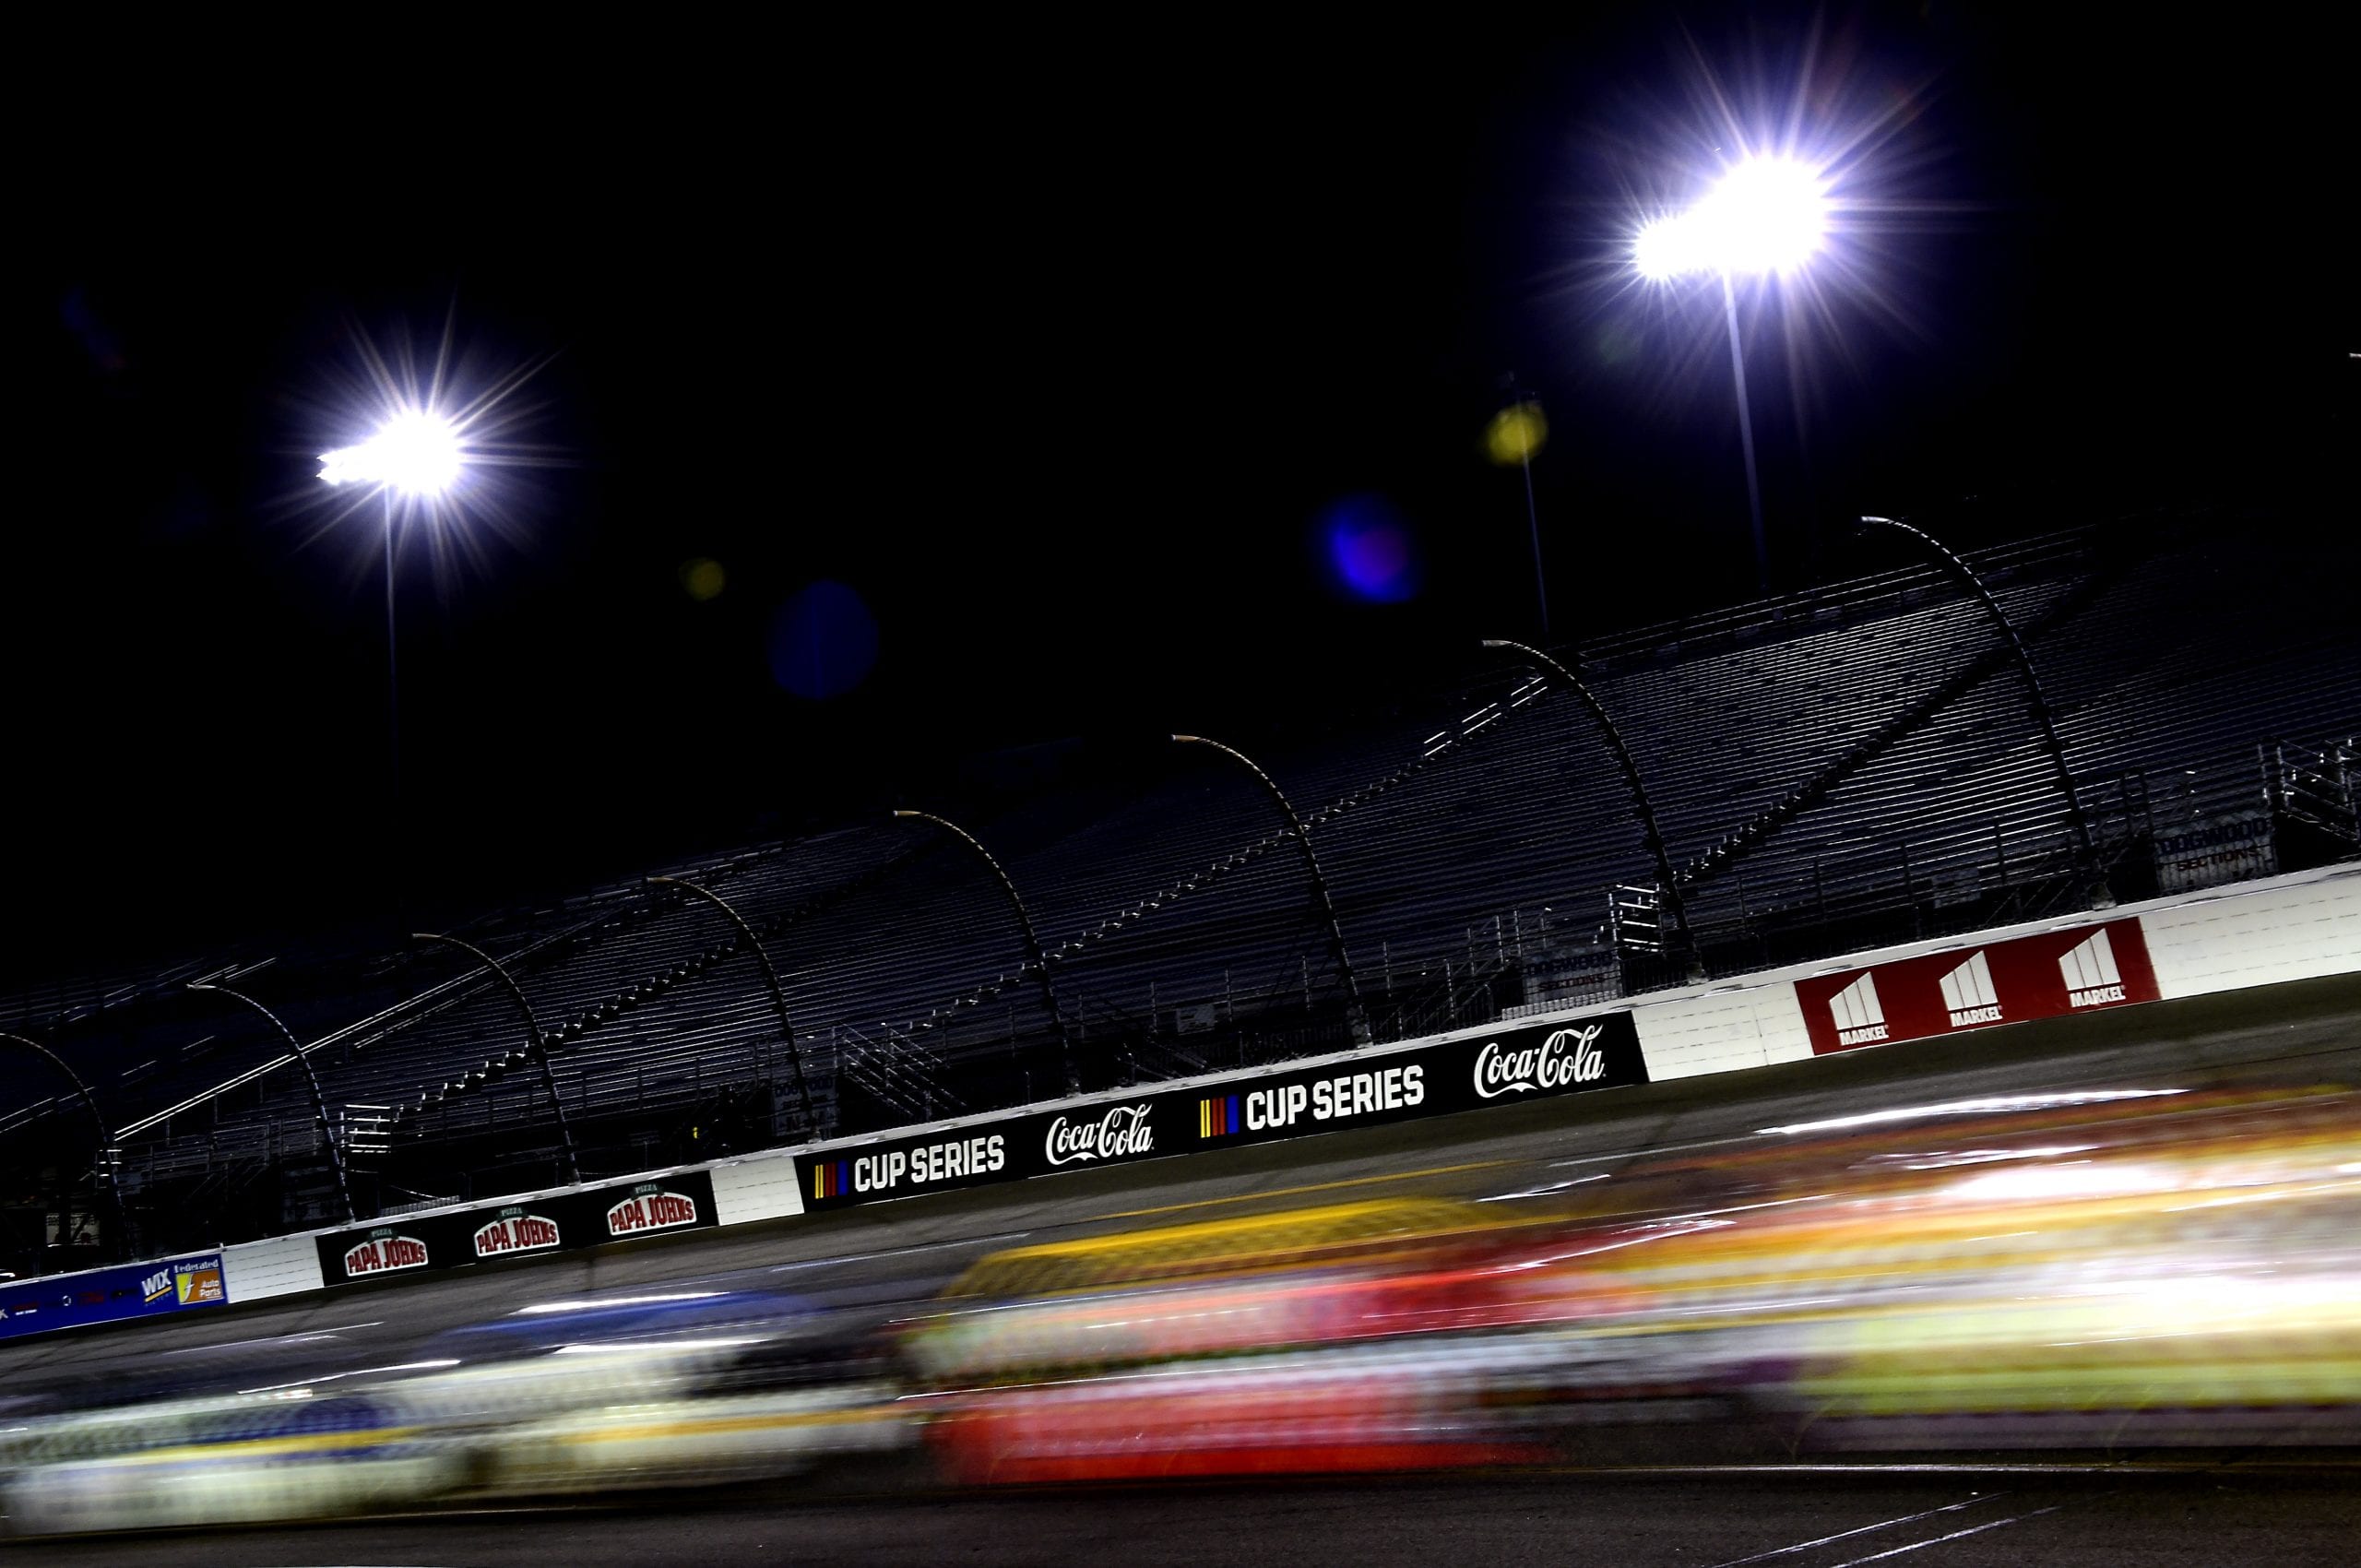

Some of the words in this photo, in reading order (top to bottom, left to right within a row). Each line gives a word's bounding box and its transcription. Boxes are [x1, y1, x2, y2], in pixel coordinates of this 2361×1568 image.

[2070, 985, 2126, 1008] MARKEL
[1950, 1005, 2002, 1028] MARKEL
[1839, 1026, 1889, 1046] MARKEL
[1474, 1024, 1606, 1099] Coca-Cola
[1246, 1086, 1308, 1131] CUP
[1312, 1064, 1424, 1121] SERIES
[1046, 1103, 1154, 1166] Coca-Cola
[854, 1150, 906, 1193] CUP
[910, 1134, 1005, 1183] SERIES
[610, 1199, 647, 1232] PAPA
[648, 1195, 694, 1227] JOHNS
[477, 1222, 513, 1254] PAPA
[513, 1218, 558, 1248] JOHNS
[173, 1258, 219, 1273] Federated
[347, 1242, 382, 1274] PAPA
[383, 1240, 426, 1268] JOHNS
[141, 1267, 172, 1297] WIX
[200, 1288, 222, 1299] Parts
[201, 1279, 220, 1289] Auto
